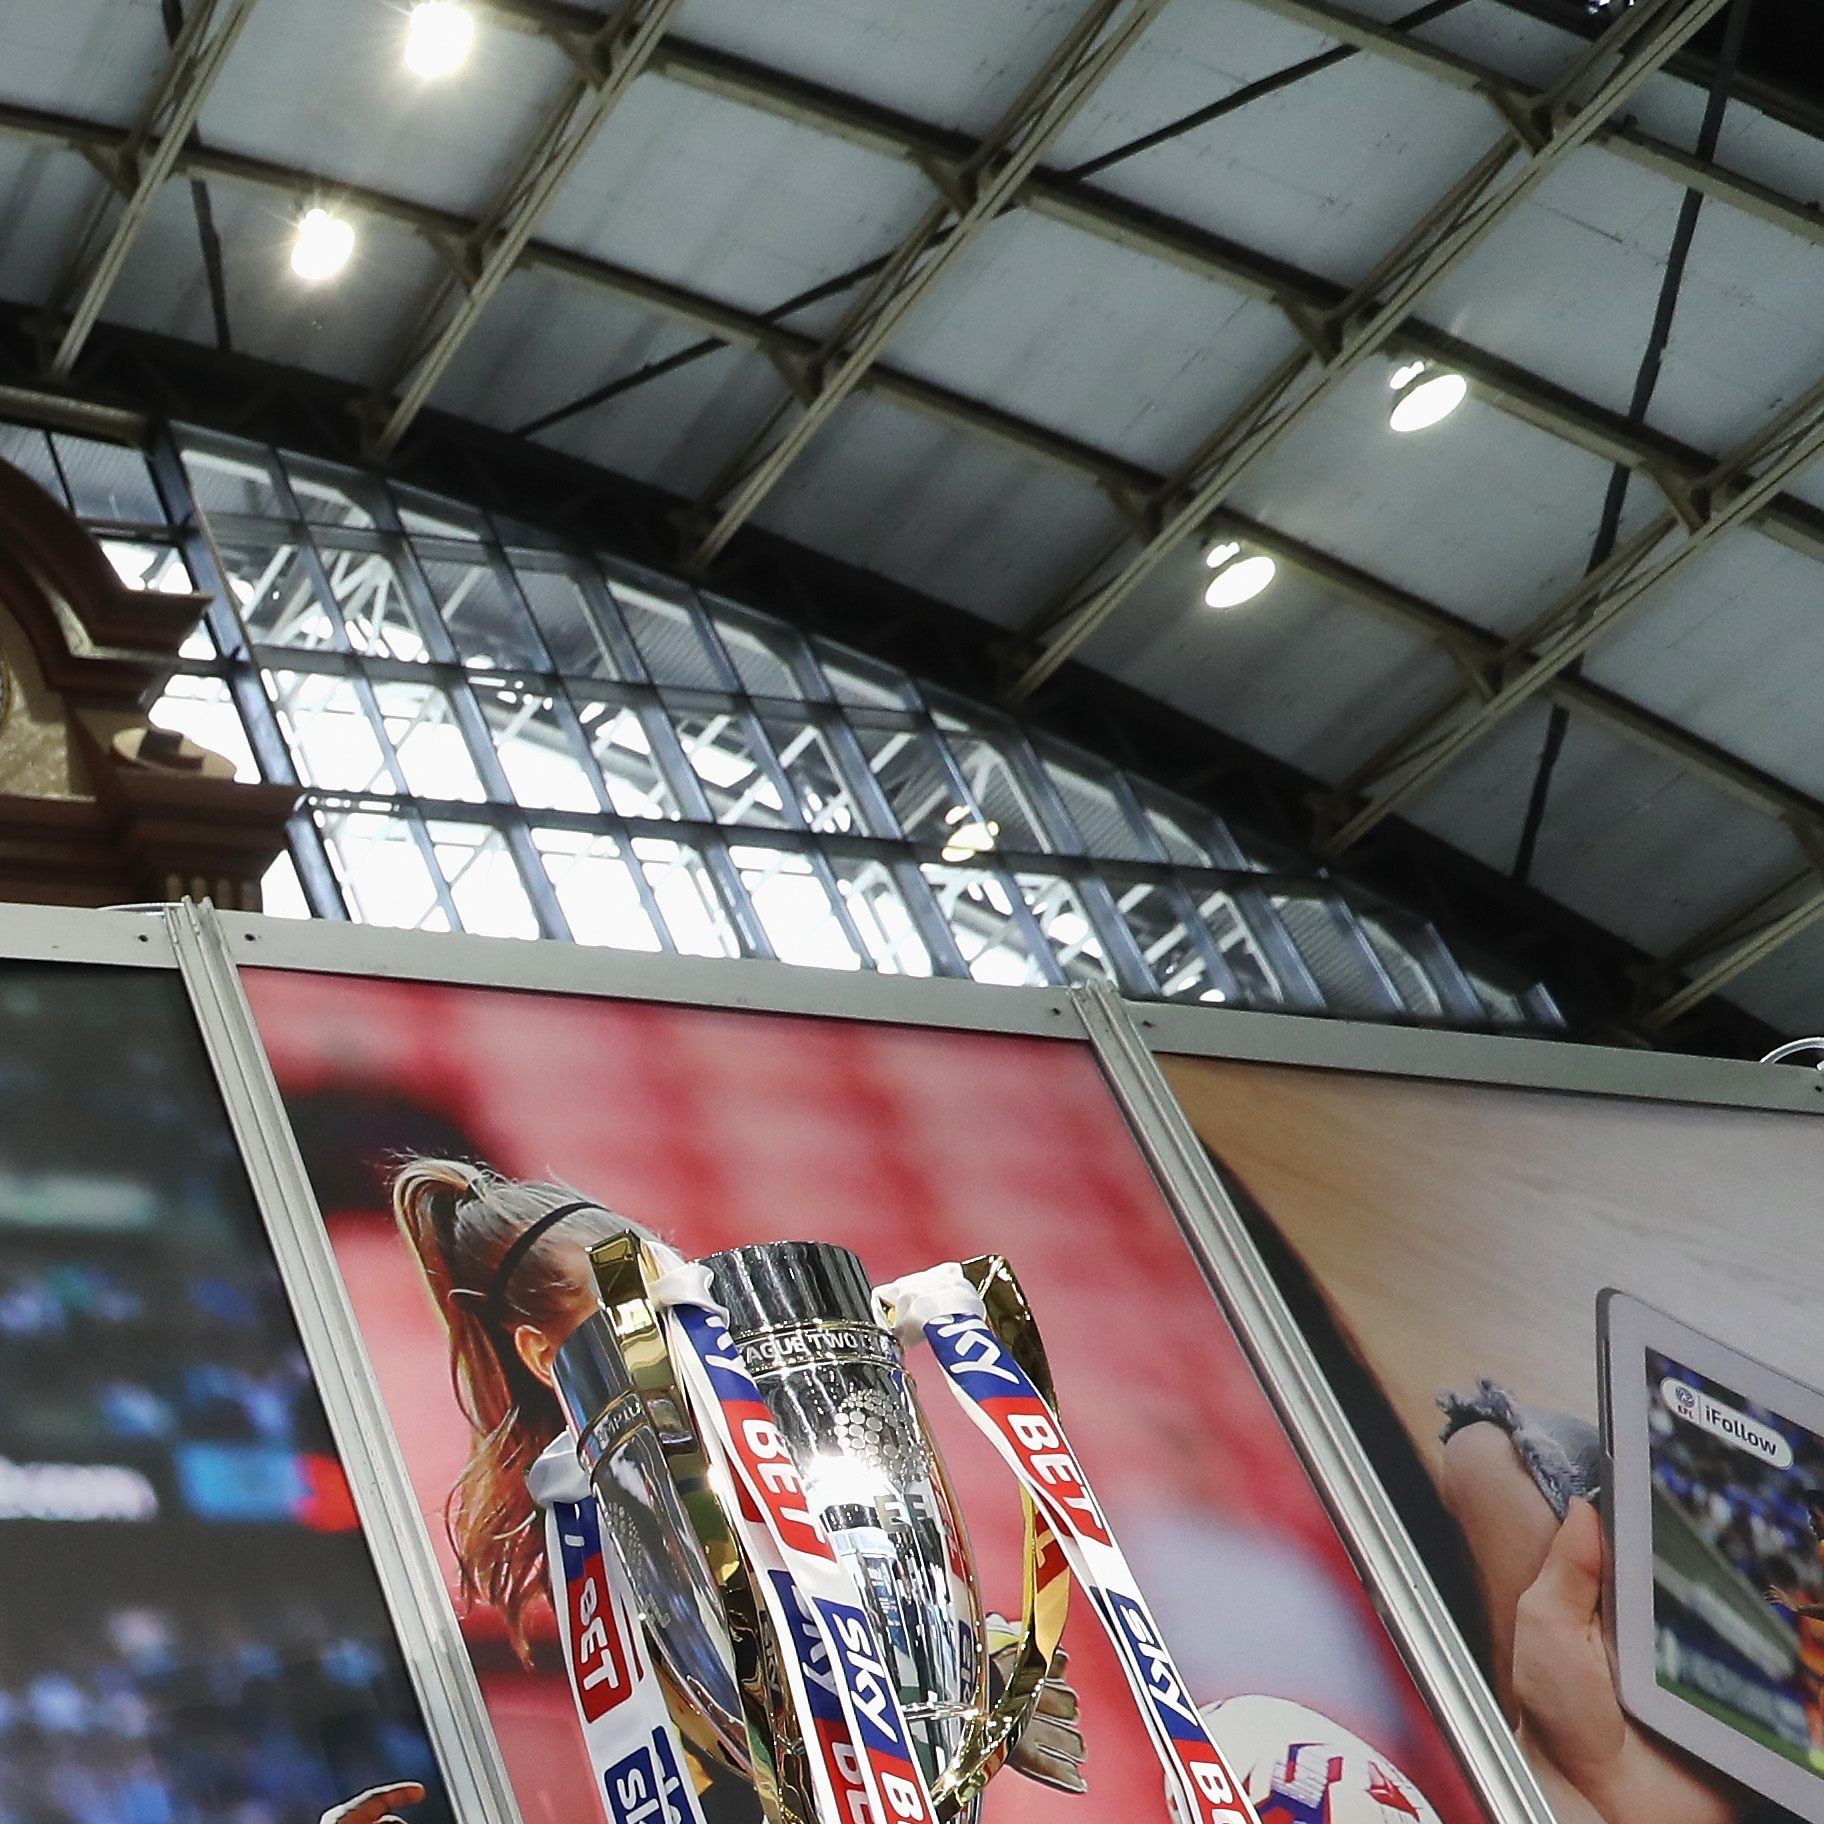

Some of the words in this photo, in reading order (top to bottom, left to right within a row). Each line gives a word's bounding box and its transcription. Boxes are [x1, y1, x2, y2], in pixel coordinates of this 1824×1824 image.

[744, 1331, 803, 1364] AGUE
[742, 1419, 827, 1544] BET
[929, 1314, 1020, 1385] ky
[1007, 1414, 1104, 1530] BET
[1705, 1405, 1777, 1457] iFollow
[831, 1612, 899, 1744] sky
[1119, 1604, 1199, 1727] sky
